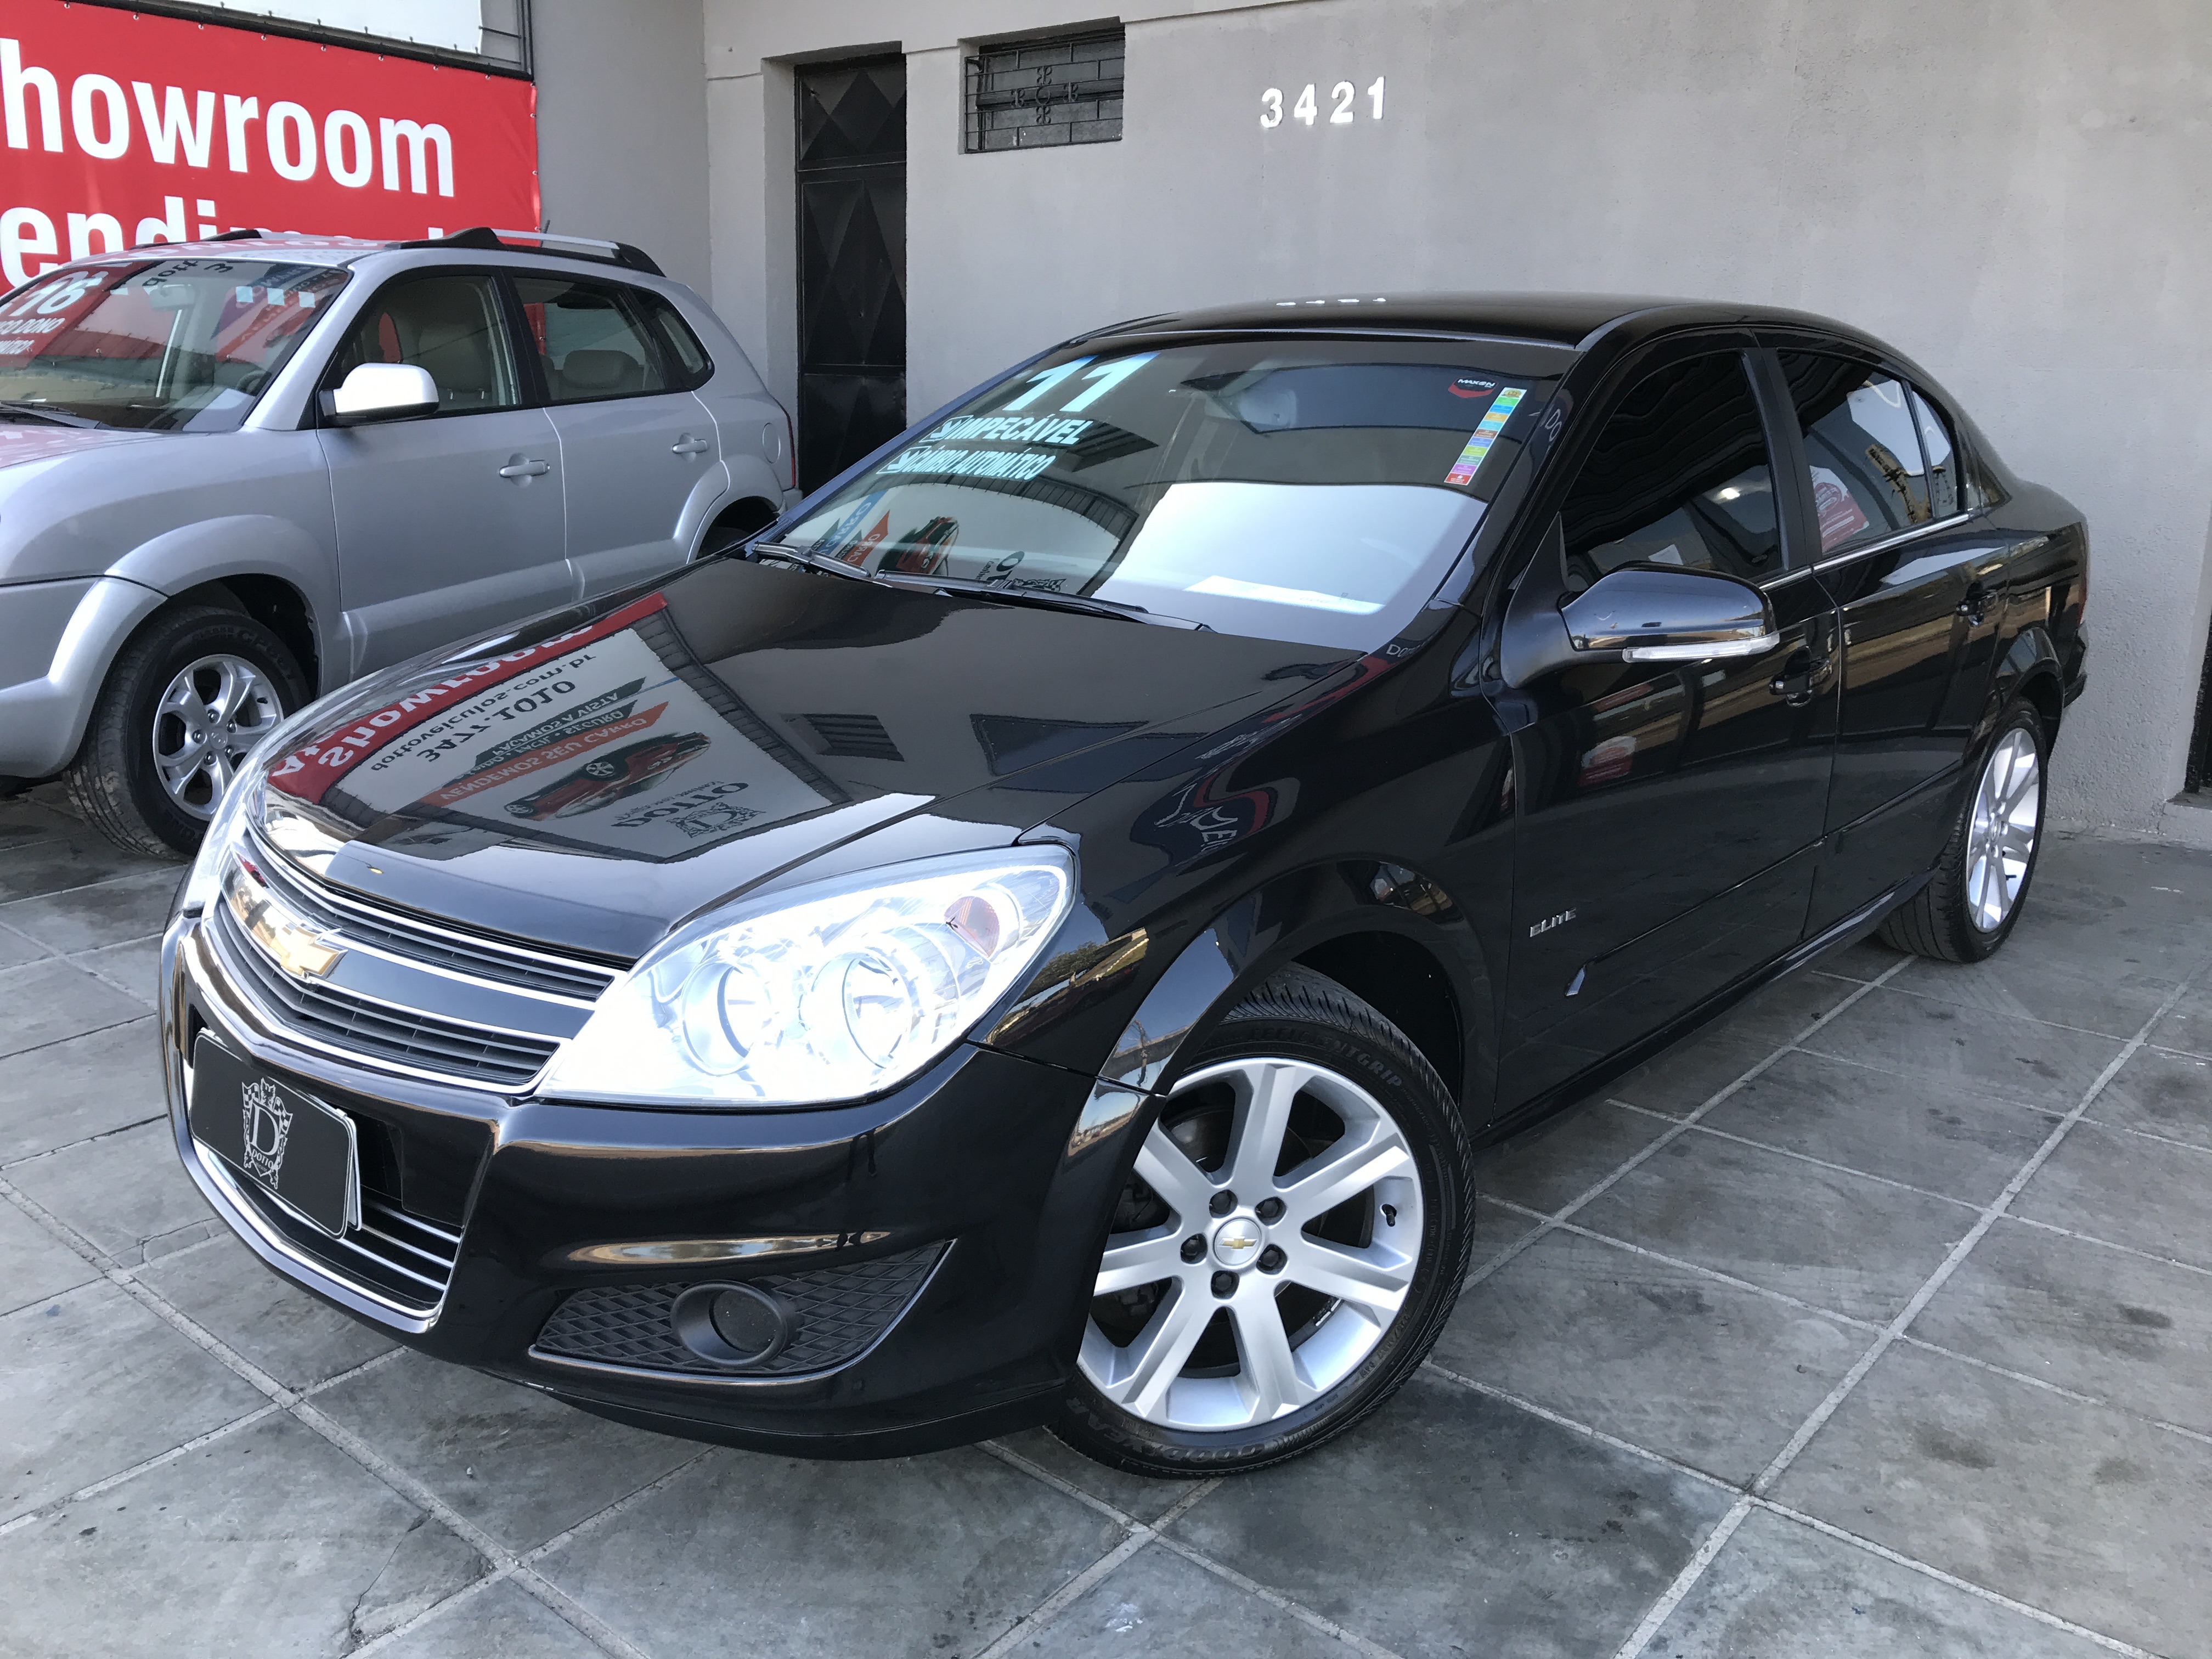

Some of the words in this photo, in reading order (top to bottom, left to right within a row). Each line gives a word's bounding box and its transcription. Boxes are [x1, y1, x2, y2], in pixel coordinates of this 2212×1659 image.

[1260, 76, 1386, 128] 3421
[1002, 351, 1161, 413] 11
[944, 413, 1094, 445] IMPECÁVEL
[904, 445, 969, 474] CÂMBIO
[953, 448, 1057, 481] AUTOMÁTICO
[1530, 907, 1577, 938] ELITE
